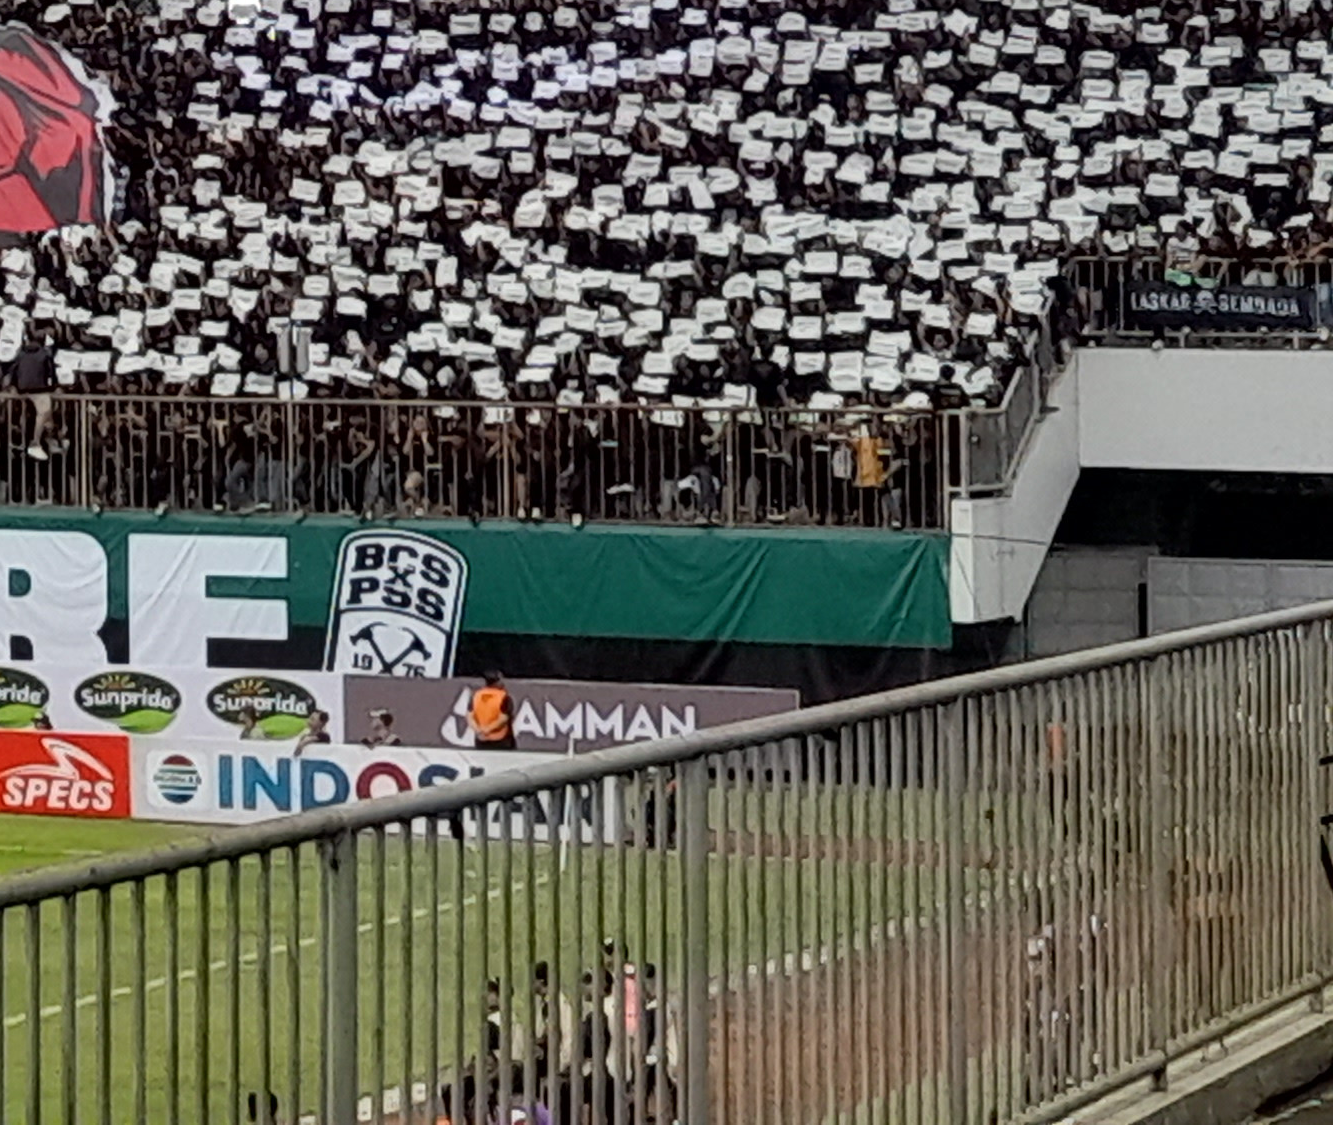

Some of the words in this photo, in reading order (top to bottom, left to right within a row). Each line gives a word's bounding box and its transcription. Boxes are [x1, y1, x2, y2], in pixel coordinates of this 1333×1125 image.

[351, 543, 452, 588] BCS
[345, 577, 446, 622] PSS
[80, 688, 176, 713] Sunpride
[513, 699, 696, 742] AMMAN
[1, 776, 115, 812] SPECS
[217, 754, 595, 827] INDO
